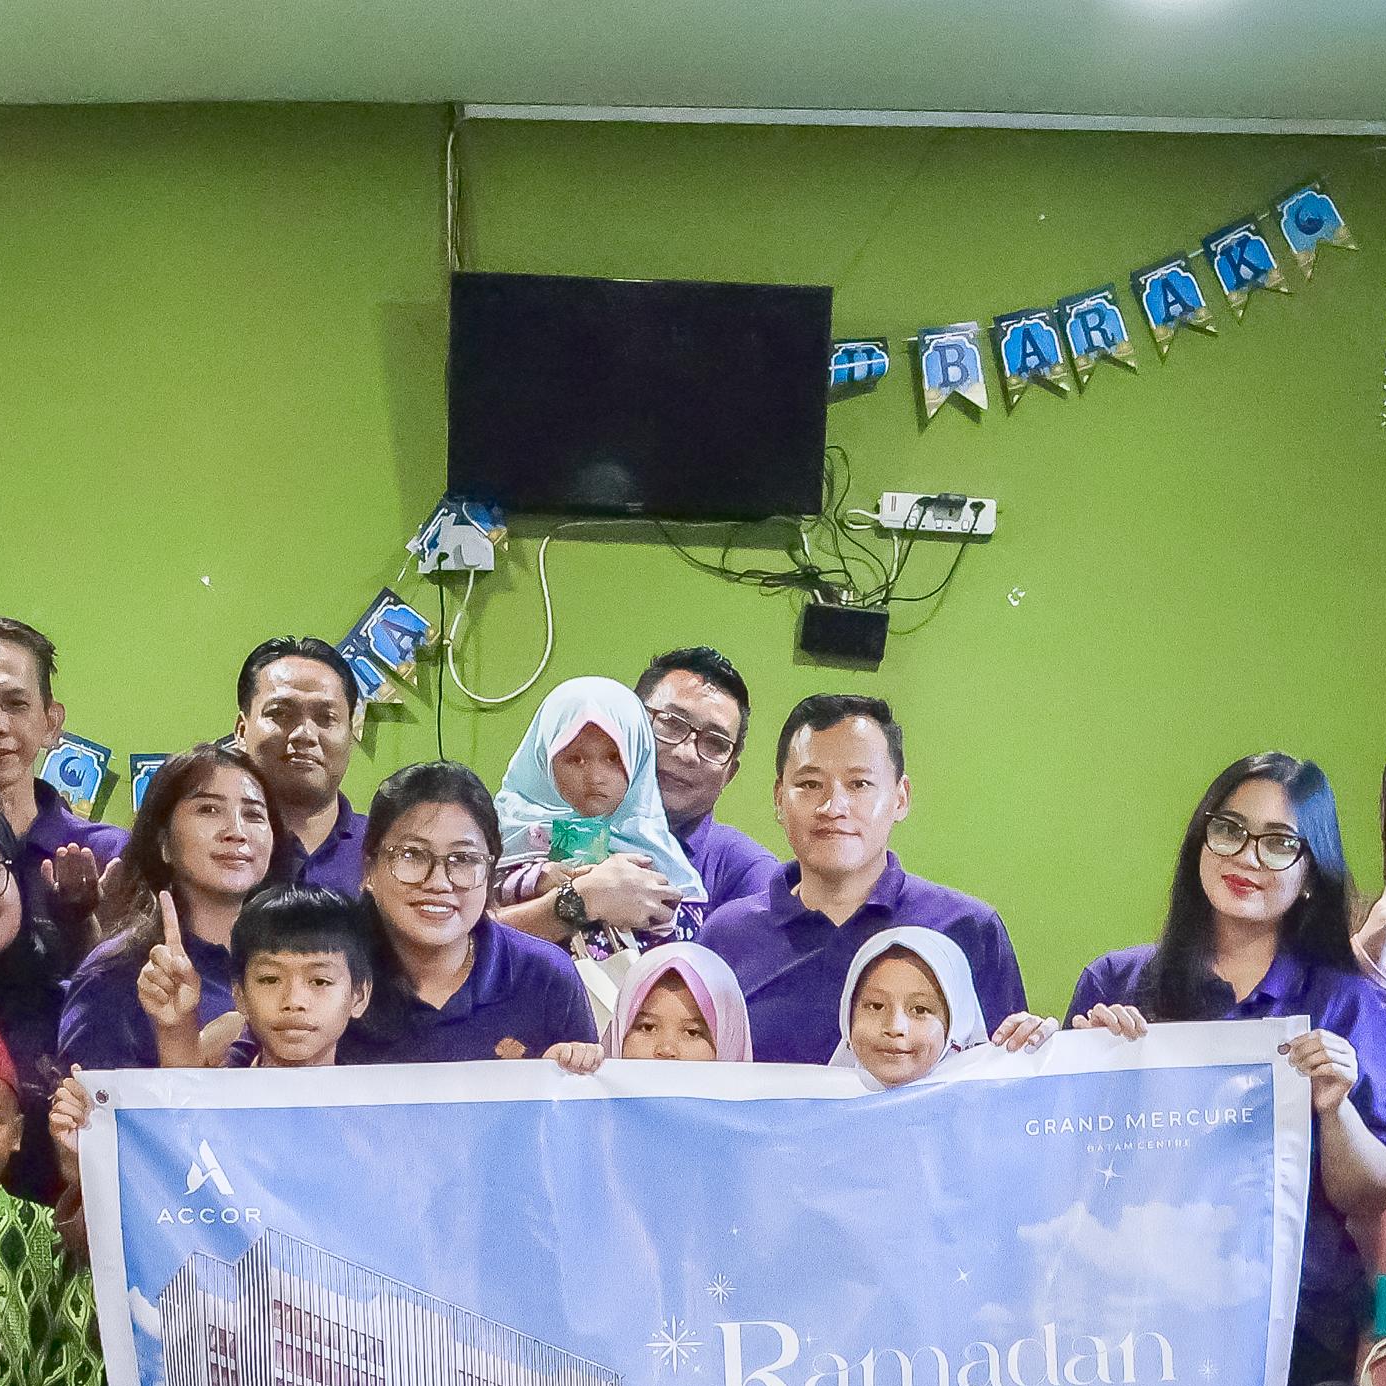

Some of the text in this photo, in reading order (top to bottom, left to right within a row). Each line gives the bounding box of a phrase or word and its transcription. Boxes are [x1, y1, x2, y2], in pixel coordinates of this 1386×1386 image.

[1025, 1107, 1255, 1136] GRAND MERCURE
[1086, 1141, 1134, 1153] BATAM
[156, 1207, 262, 1224] ACCOR
